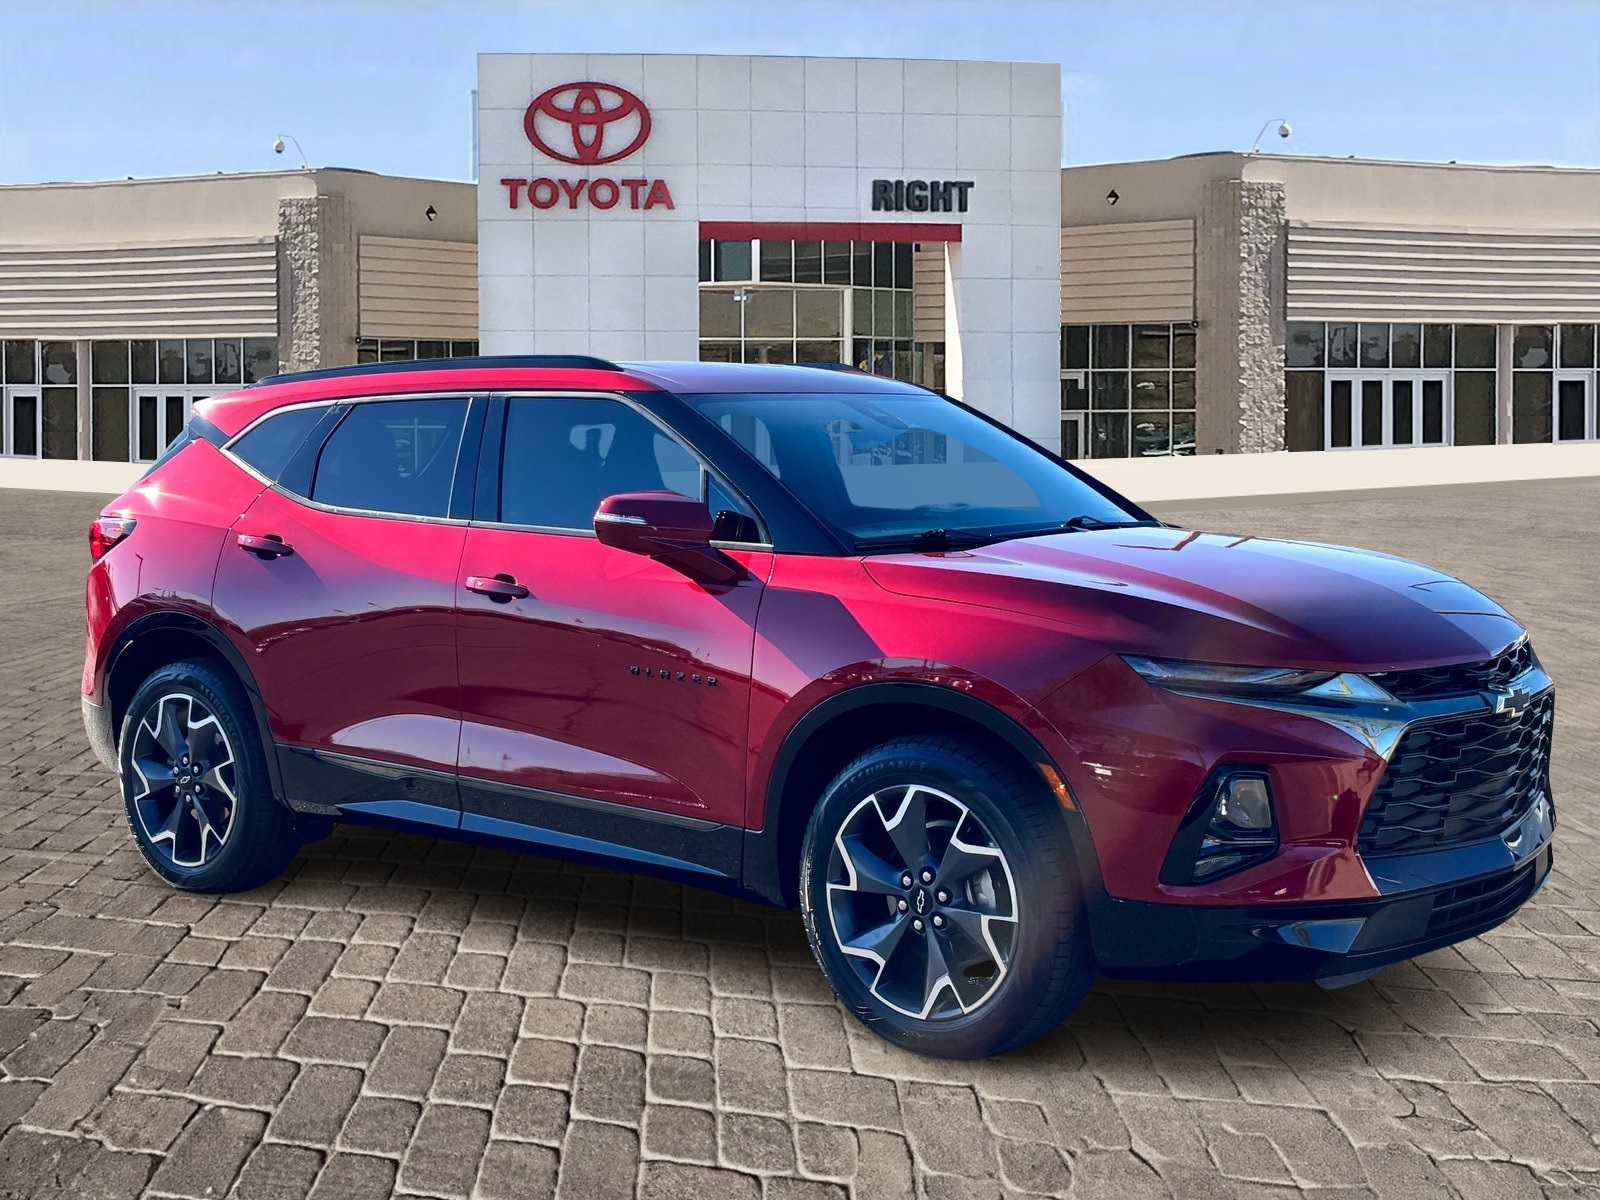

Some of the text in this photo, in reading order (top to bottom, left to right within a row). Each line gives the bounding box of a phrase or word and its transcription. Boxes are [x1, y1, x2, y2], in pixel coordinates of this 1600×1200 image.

[500, 178, 675, 210] TOYOTA
[872, 180, 974, 212] RIGHT
[630, 665, 718, 687] BLAZER
